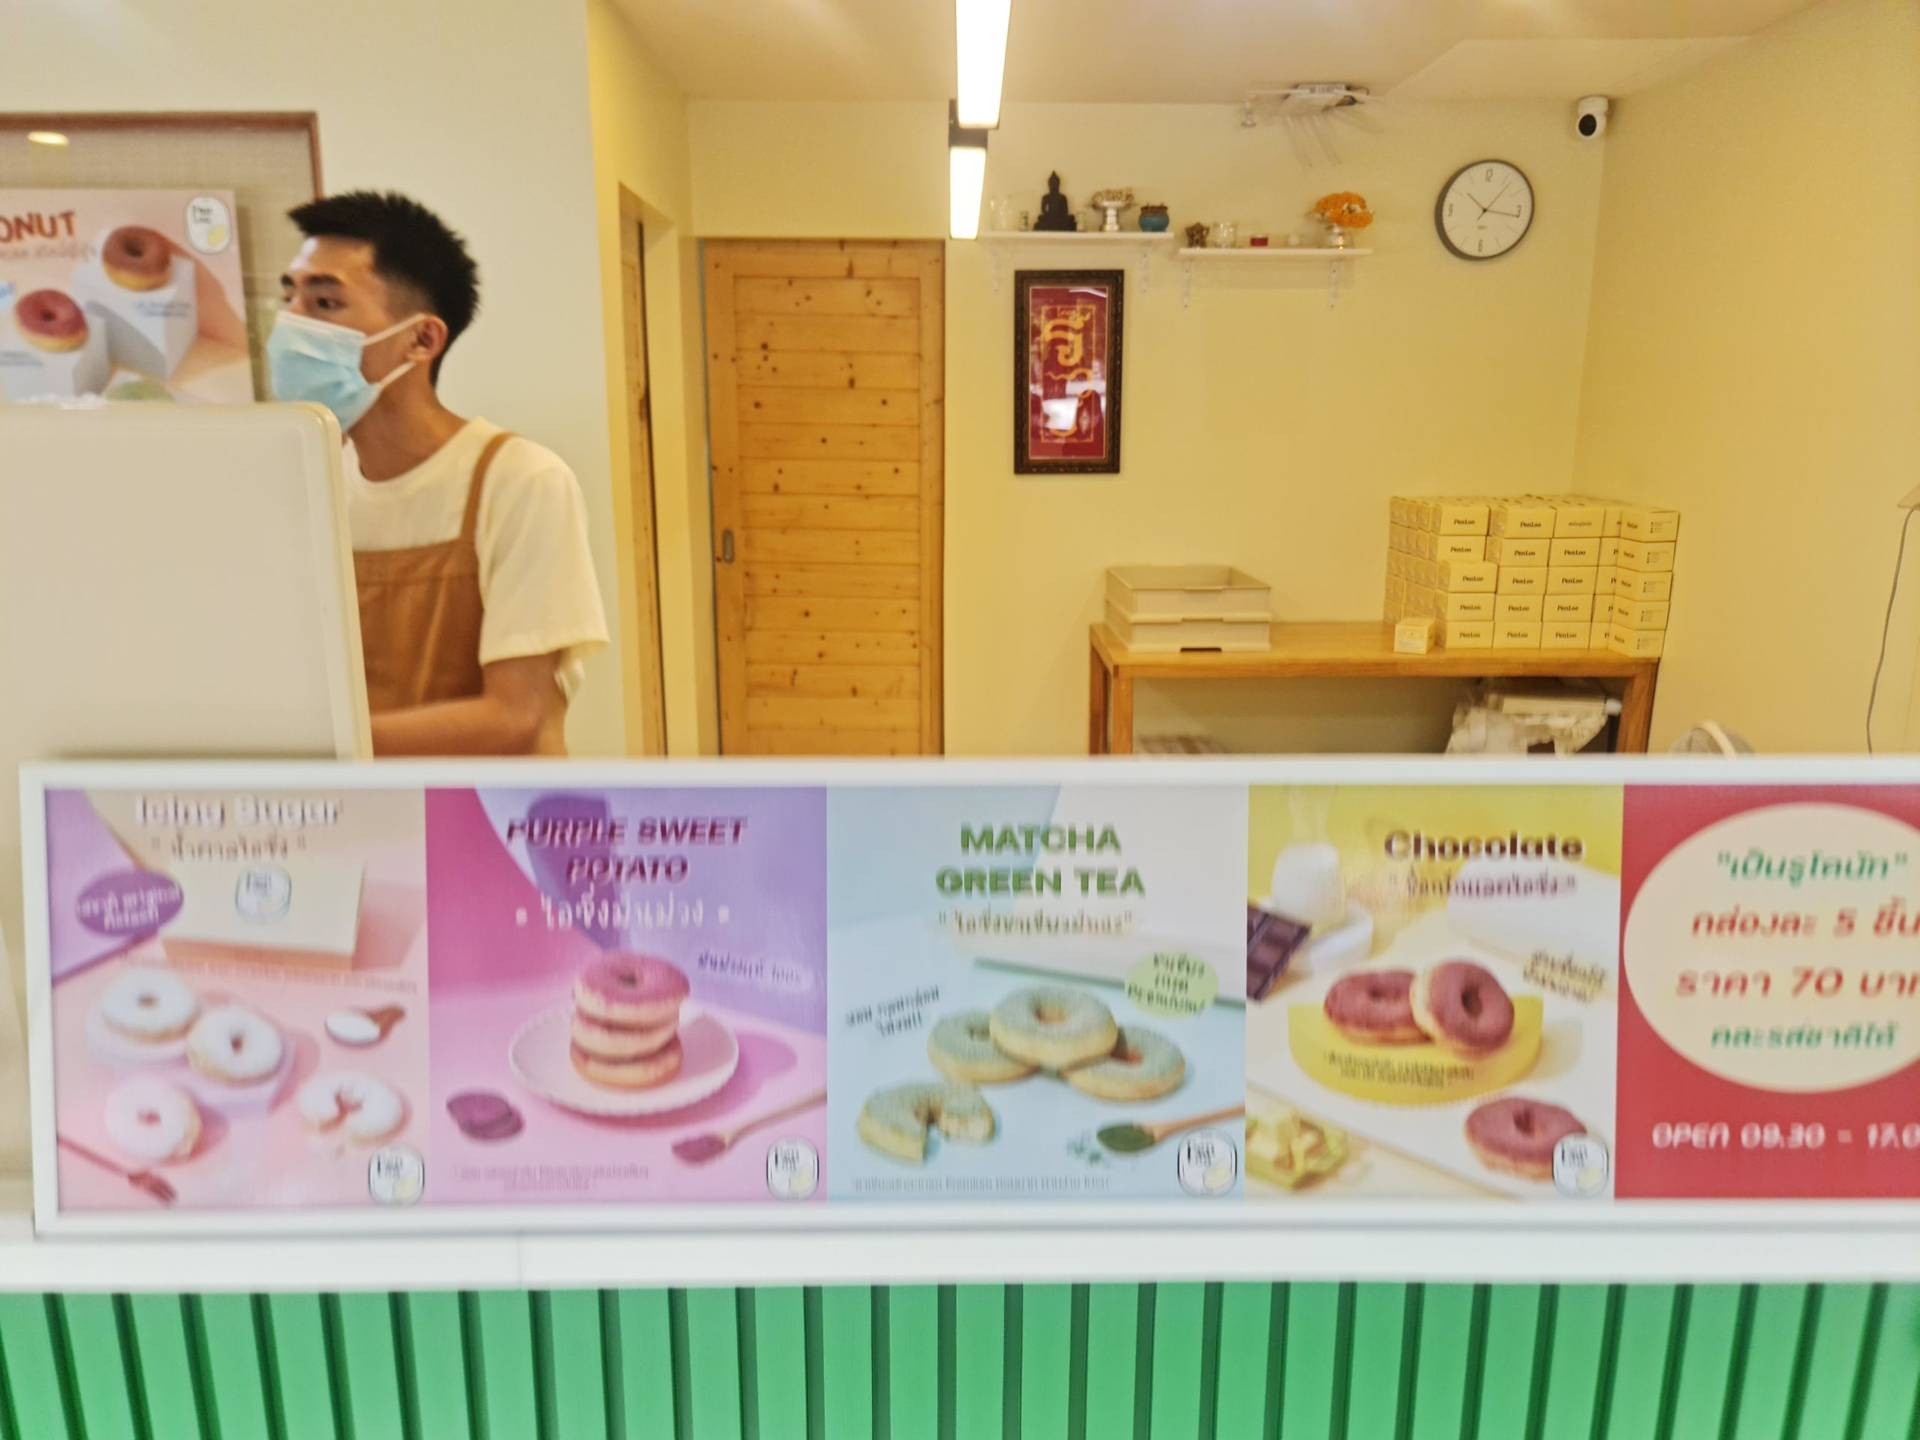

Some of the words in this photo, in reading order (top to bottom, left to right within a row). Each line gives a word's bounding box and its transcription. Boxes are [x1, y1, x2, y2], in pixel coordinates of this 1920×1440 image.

[507, 815, 629, 848] PURPLE
[638, 815, 747, 848] SWEET
[959, 822, 1122, 854] MATCHA
[1383, 829, 1585, 861] Chocolate
[565, 854, 691, 885] POTATO
[935, 865, 1064, 898] GREEN
[1074, 866, 1147, 897] TEA
[1833, 909, 1858, 937] 5
[1676, 968, 1772, 998] ราคา
[1790, 966, 1844, 998] 70
[1652, 1122, 1730, 1150] OPEN
